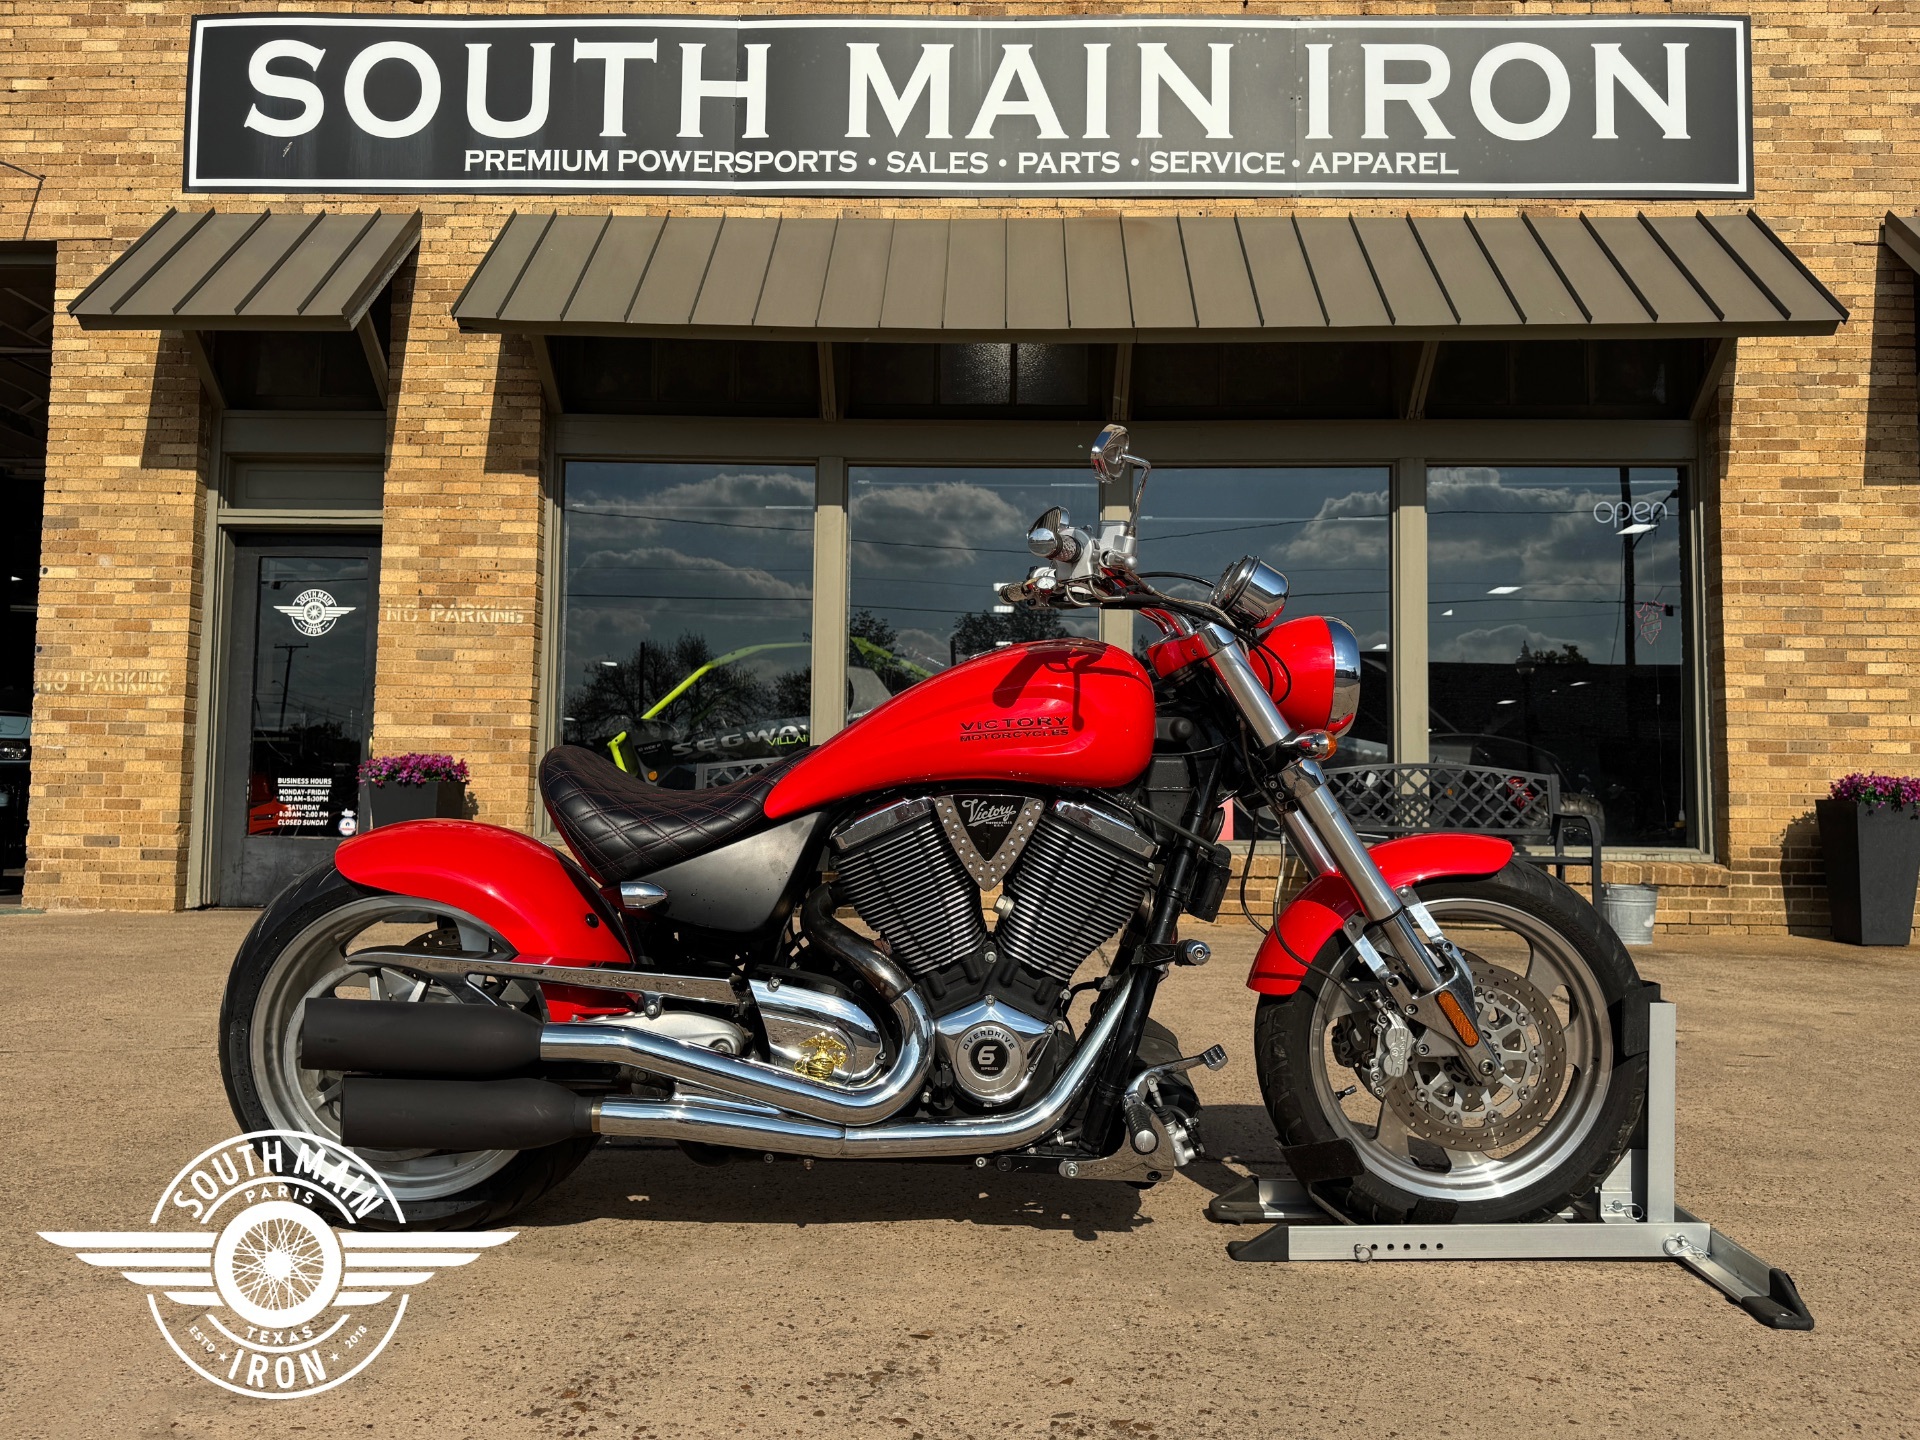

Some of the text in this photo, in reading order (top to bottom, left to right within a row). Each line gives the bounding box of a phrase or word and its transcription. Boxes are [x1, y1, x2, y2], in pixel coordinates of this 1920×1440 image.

[244, 38, 1691, 140] SOUTH MAIN IRON
[464, 149, 1460, 174] PREMIUM POWERSPORTS SALES PARTS SERVICE APPAREL
[1593, 501, 1668, 528] open
[296, 590, 334, 607] SOUTH MAIN
[386, 603, 525, 624] NO PARKING
[304, 626, 322, 635] IRON
[37, 671, 172, 693] NO PARKING
[960, 716, 1068, 731] VICTORY
[766, 734, 809, 747] VILLAI
[960, 729, 1069, 742] MOTORCYCLES
[961, 798, 1017, 827] Victory
[963, 1030, 1015, 1050] OVERDRIVE
[977, 1045, 998, 1065] 6
